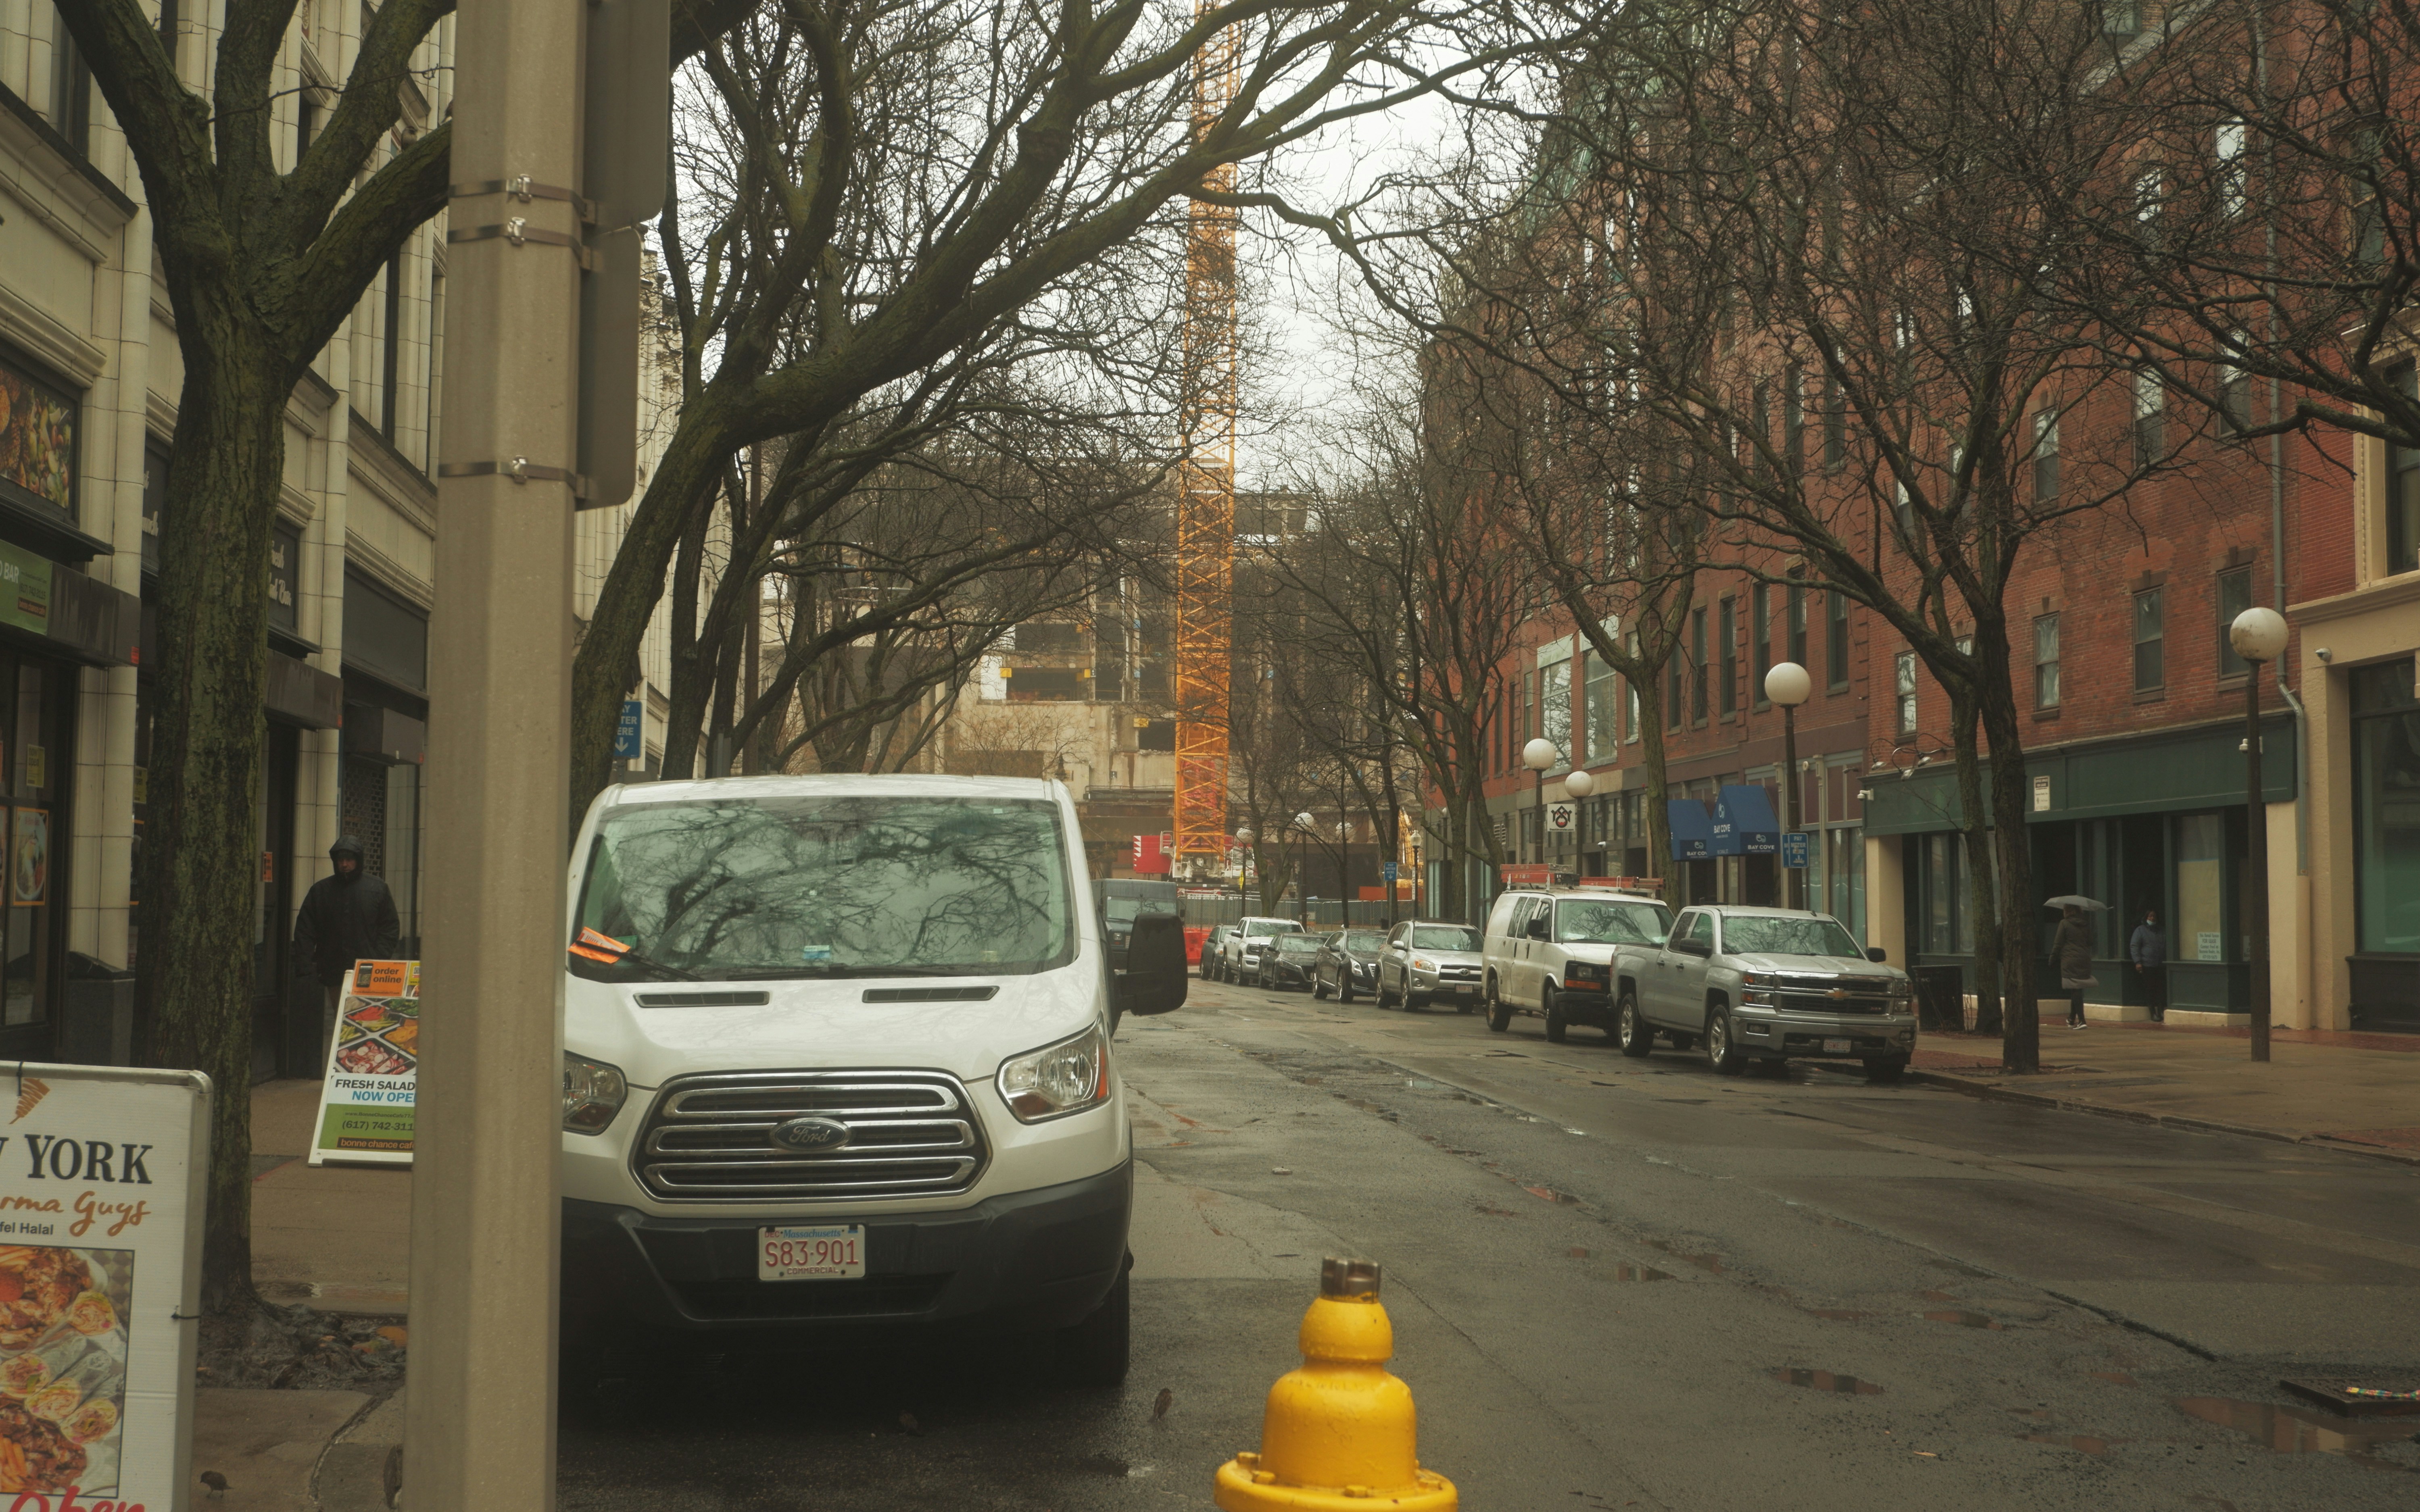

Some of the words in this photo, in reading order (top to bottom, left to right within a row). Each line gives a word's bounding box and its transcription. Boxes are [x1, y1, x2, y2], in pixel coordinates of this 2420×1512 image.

[4, 562, 19, 584] BAR
[621, 716, 637, 724] TER
[617, 727, 634, 735] ERE
[1721, 824, 1730, 832] COVE
[335, 1079, 375, 1089] FRESH
[352, 1091, 384, 1101] NOW
[342, 1120, 369, 1131] (617)
[372, 1122, 414, 1131] 742-311
[789, 1126, 830, 1143] Ford
[341, 1139, 367, 1147] bonne
[368, 1140, 398, 1148] chance
[25, 1134, 153, 1184] YORK
[69, 1191, 152, 1237] Guys
[20, 1222, 54, 1235] Halal
[783, 1229, 841, 1238] Massachusetts
[787, 1266, 839, 1275] COMMERCIAL
